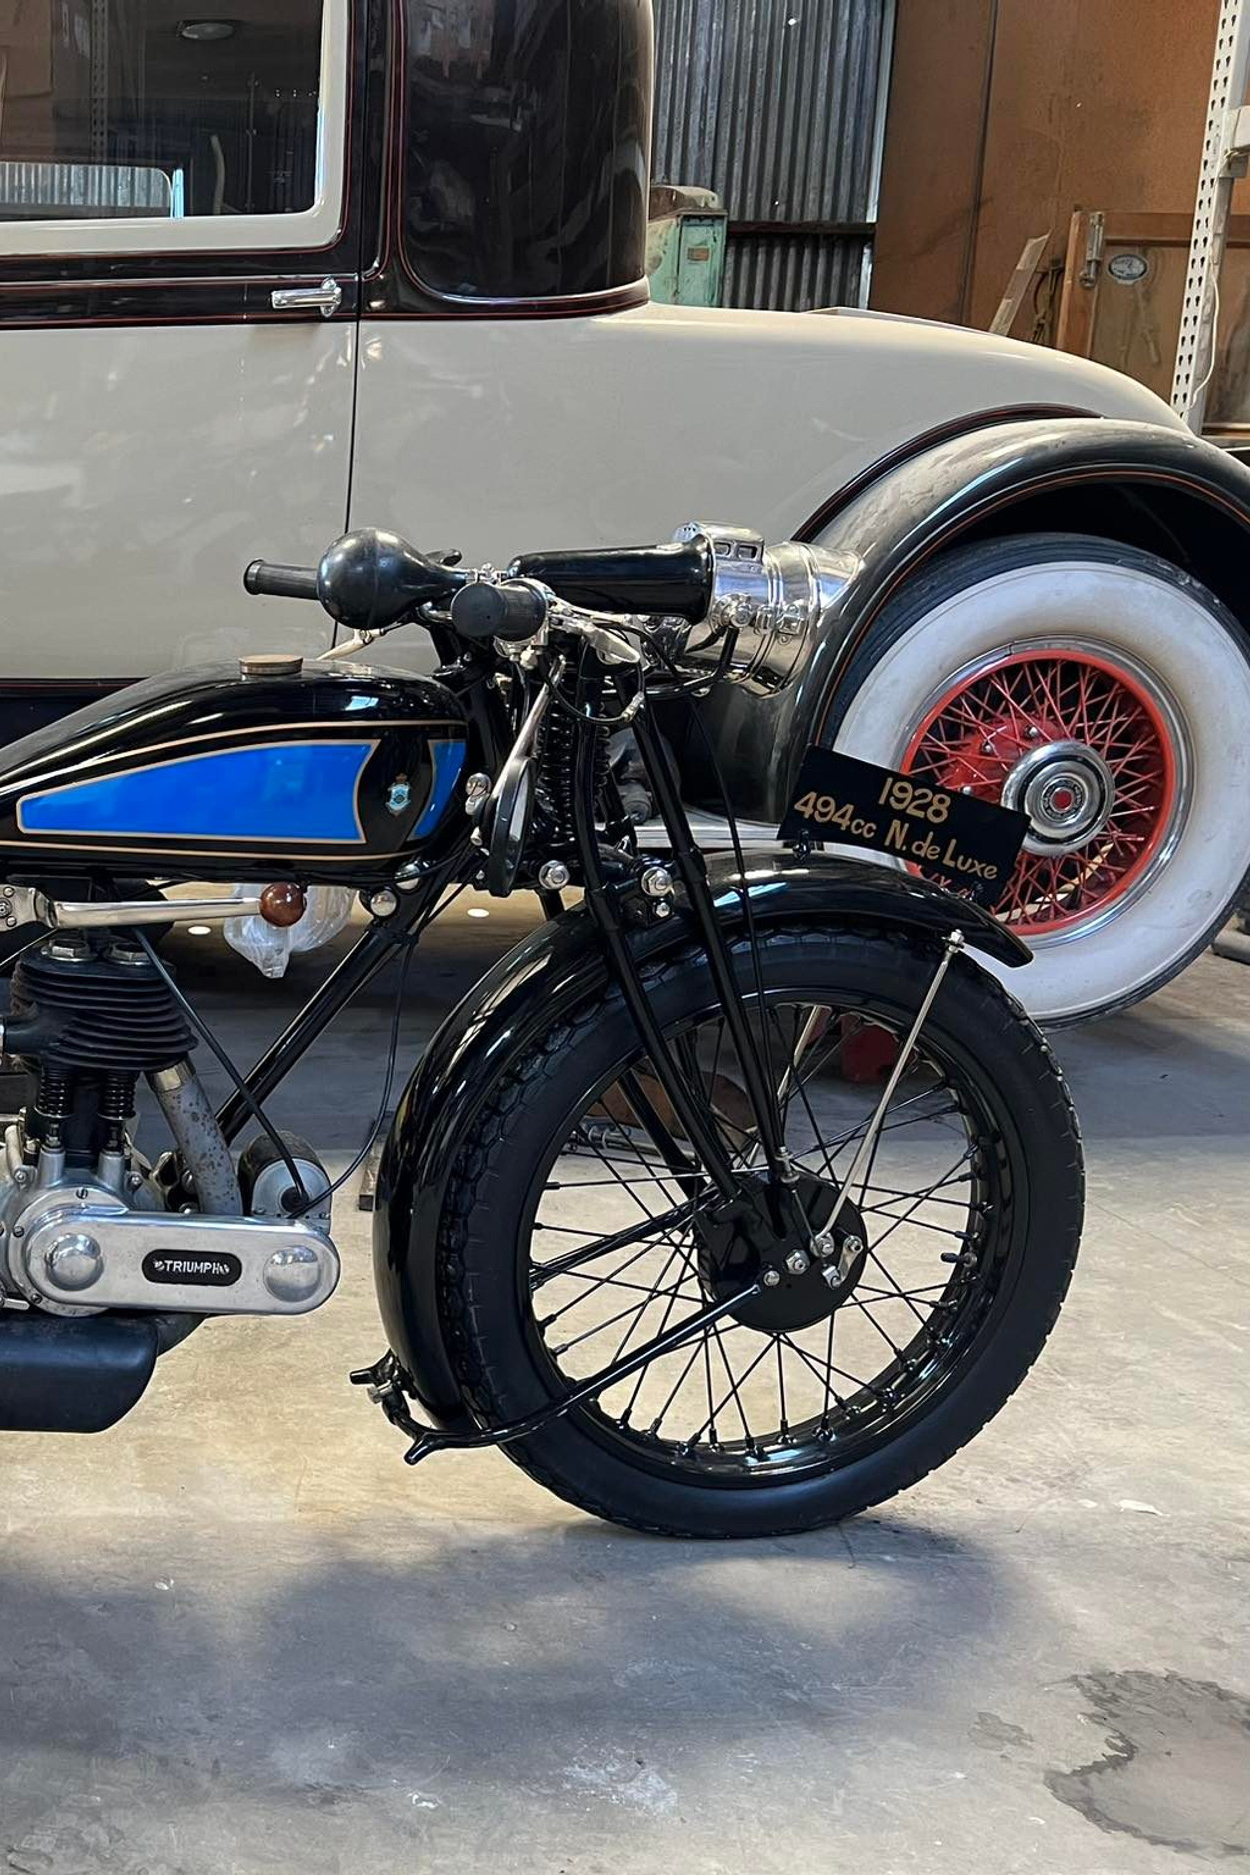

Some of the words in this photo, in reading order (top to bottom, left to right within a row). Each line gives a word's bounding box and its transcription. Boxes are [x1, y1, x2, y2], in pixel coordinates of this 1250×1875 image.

[879, 777, 951, 824] 1928
[794, 791, 877, 838] 494cc
[884, 819, 910, 851] N.
[912, 831, 940, 860] de
[943, 838, 998, 880] Luxe
[163, 1260, 220, 1275] TRIUMPH
